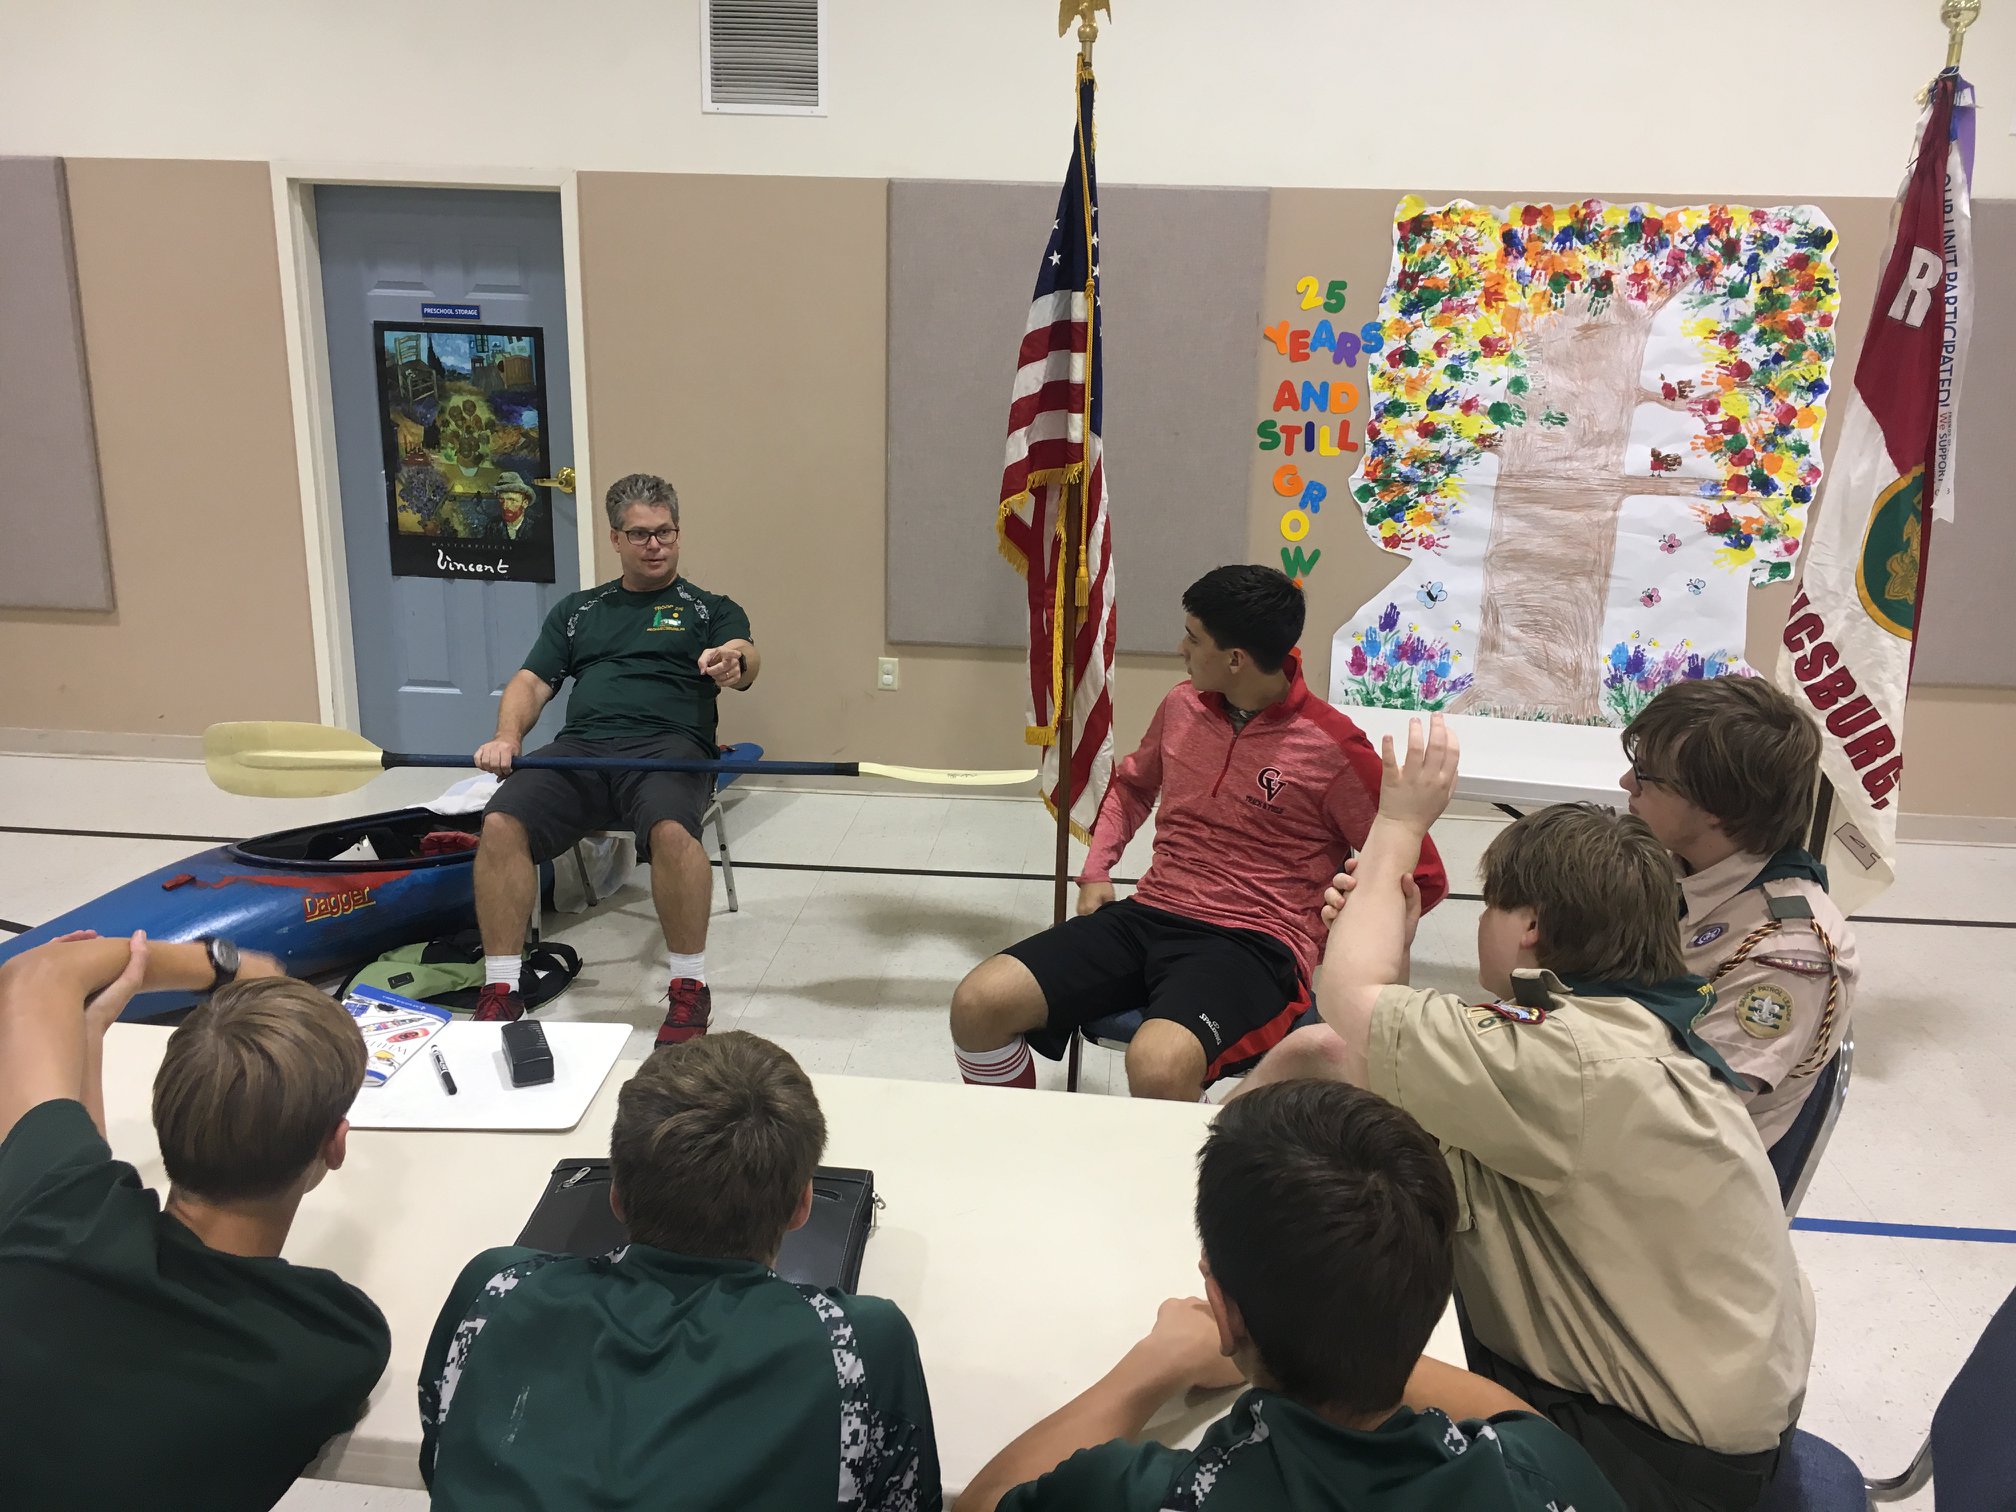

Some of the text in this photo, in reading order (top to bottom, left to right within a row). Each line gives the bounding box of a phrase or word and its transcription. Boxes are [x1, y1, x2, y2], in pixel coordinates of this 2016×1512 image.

[1296, 276, 1348, 313] 25
[1888, 246, 1944, 328] R
[423, 307, 455, 315] PRESCHOOL
[1264, 320, 1385, 367] YEARS
[1273, 380, 1359, 414] AND
[1257, 419, 1359, 456] STILL
[1939, 412, 1948, 430] We
[1273, 464, 1327, 587] GROW
[437, 549, 509, 573] Vincent
[304, 886, 374, 922] Dagger
[1758, 986, 1783, 997] PATROL
